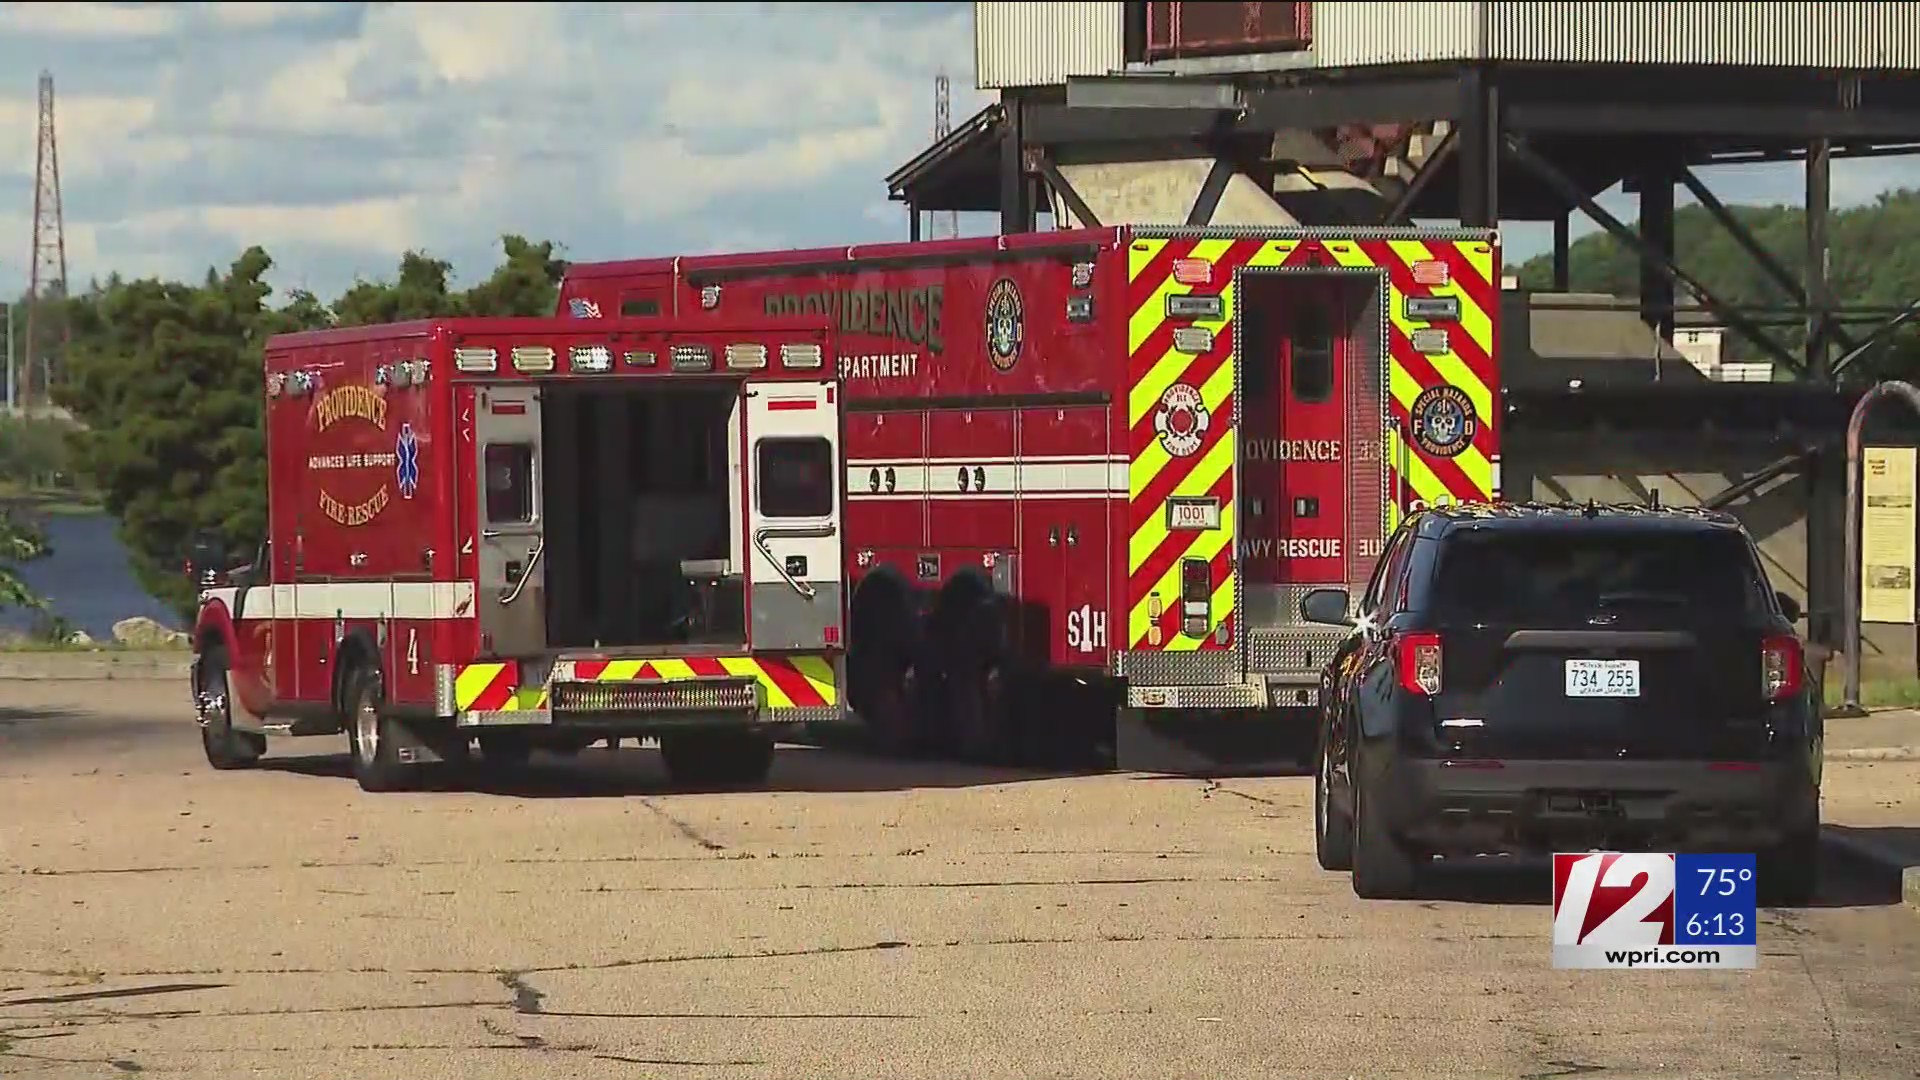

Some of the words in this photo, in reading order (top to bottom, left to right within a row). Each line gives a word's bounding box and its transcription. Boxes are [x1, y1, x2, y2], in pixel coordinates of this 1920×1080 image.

[317, 385, 387, 432] PROVIDENCE
[1414, 419, 1423, 434] F
[1464, 420, 1473, 435] D
[1243, 439, 1341, 461] OVIDENCE
[309, 455, 344, 469] ADVANCED
[346, 454, 361, 468] LIFE
[363, 453, 395, 467] SUPPORT
[1179, 506, 1205, 520] 1001
[1240, 539, 1272, 558] AVY
[1277, 538, 1341, 558] RESCUE
[1067, 604, 1106, 652] S1H
[407, 628, 419, 675] 4
[1571, 669, 1598, 687] 734
[1607, 669, 1634, 687] 255
